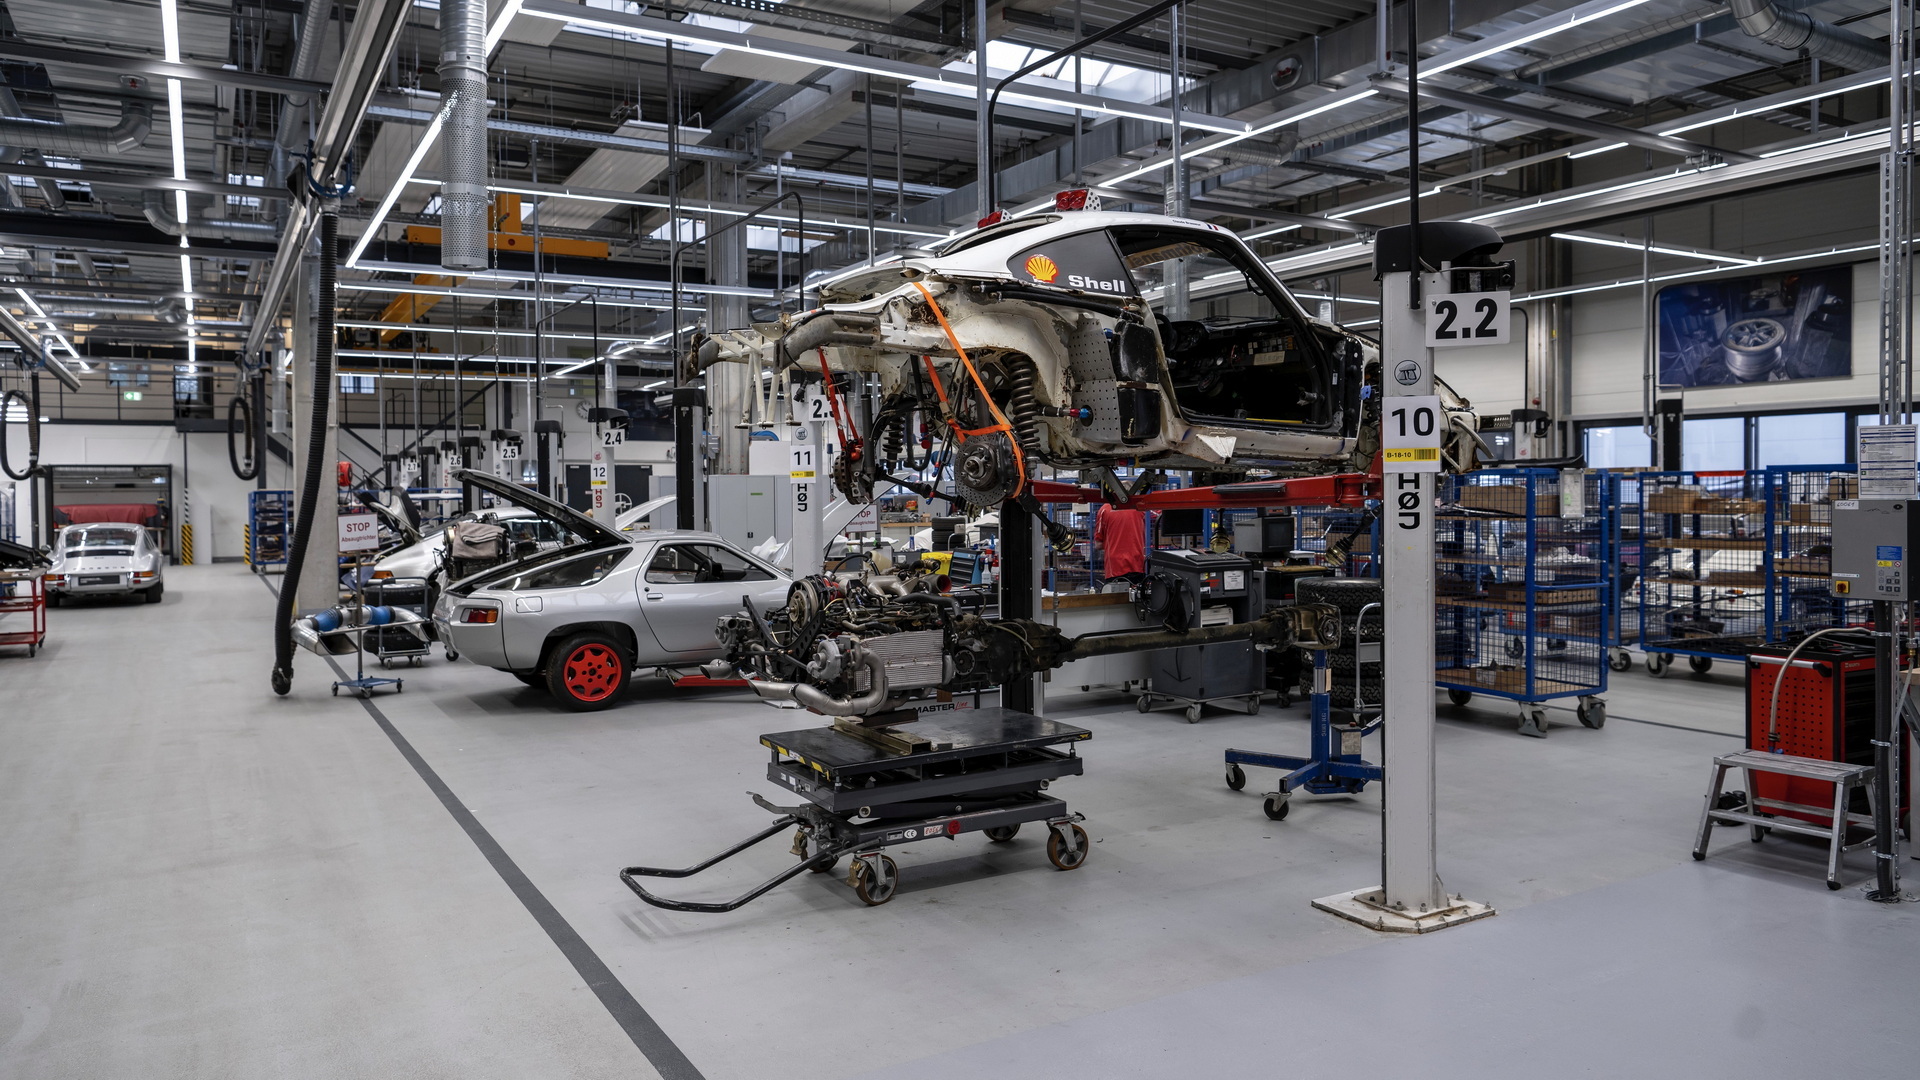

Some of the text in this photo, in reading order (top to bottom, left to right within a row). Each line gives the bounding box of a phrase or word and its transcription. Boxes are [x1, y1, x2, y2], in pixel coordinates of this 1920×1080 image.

[1068, 274, 1126, 293] Shell
[1435, 298, 1498, 340] 2.2
[1391, 407, 1435, 437] 10
[604, 432, 622, 445] 2.4
[503, 448, 516, 458] 2.5
[794, 451, 811, 465] 11
[450, 456, 461, 465] 2.6
[593, 467, 606, 477] 12
[858, 510, 871, 518] OP
[346, 522, 370, 532] STOP
[341, 534, 377, 543] Absaugtrichter
[906, 830, 915, 838] CE
